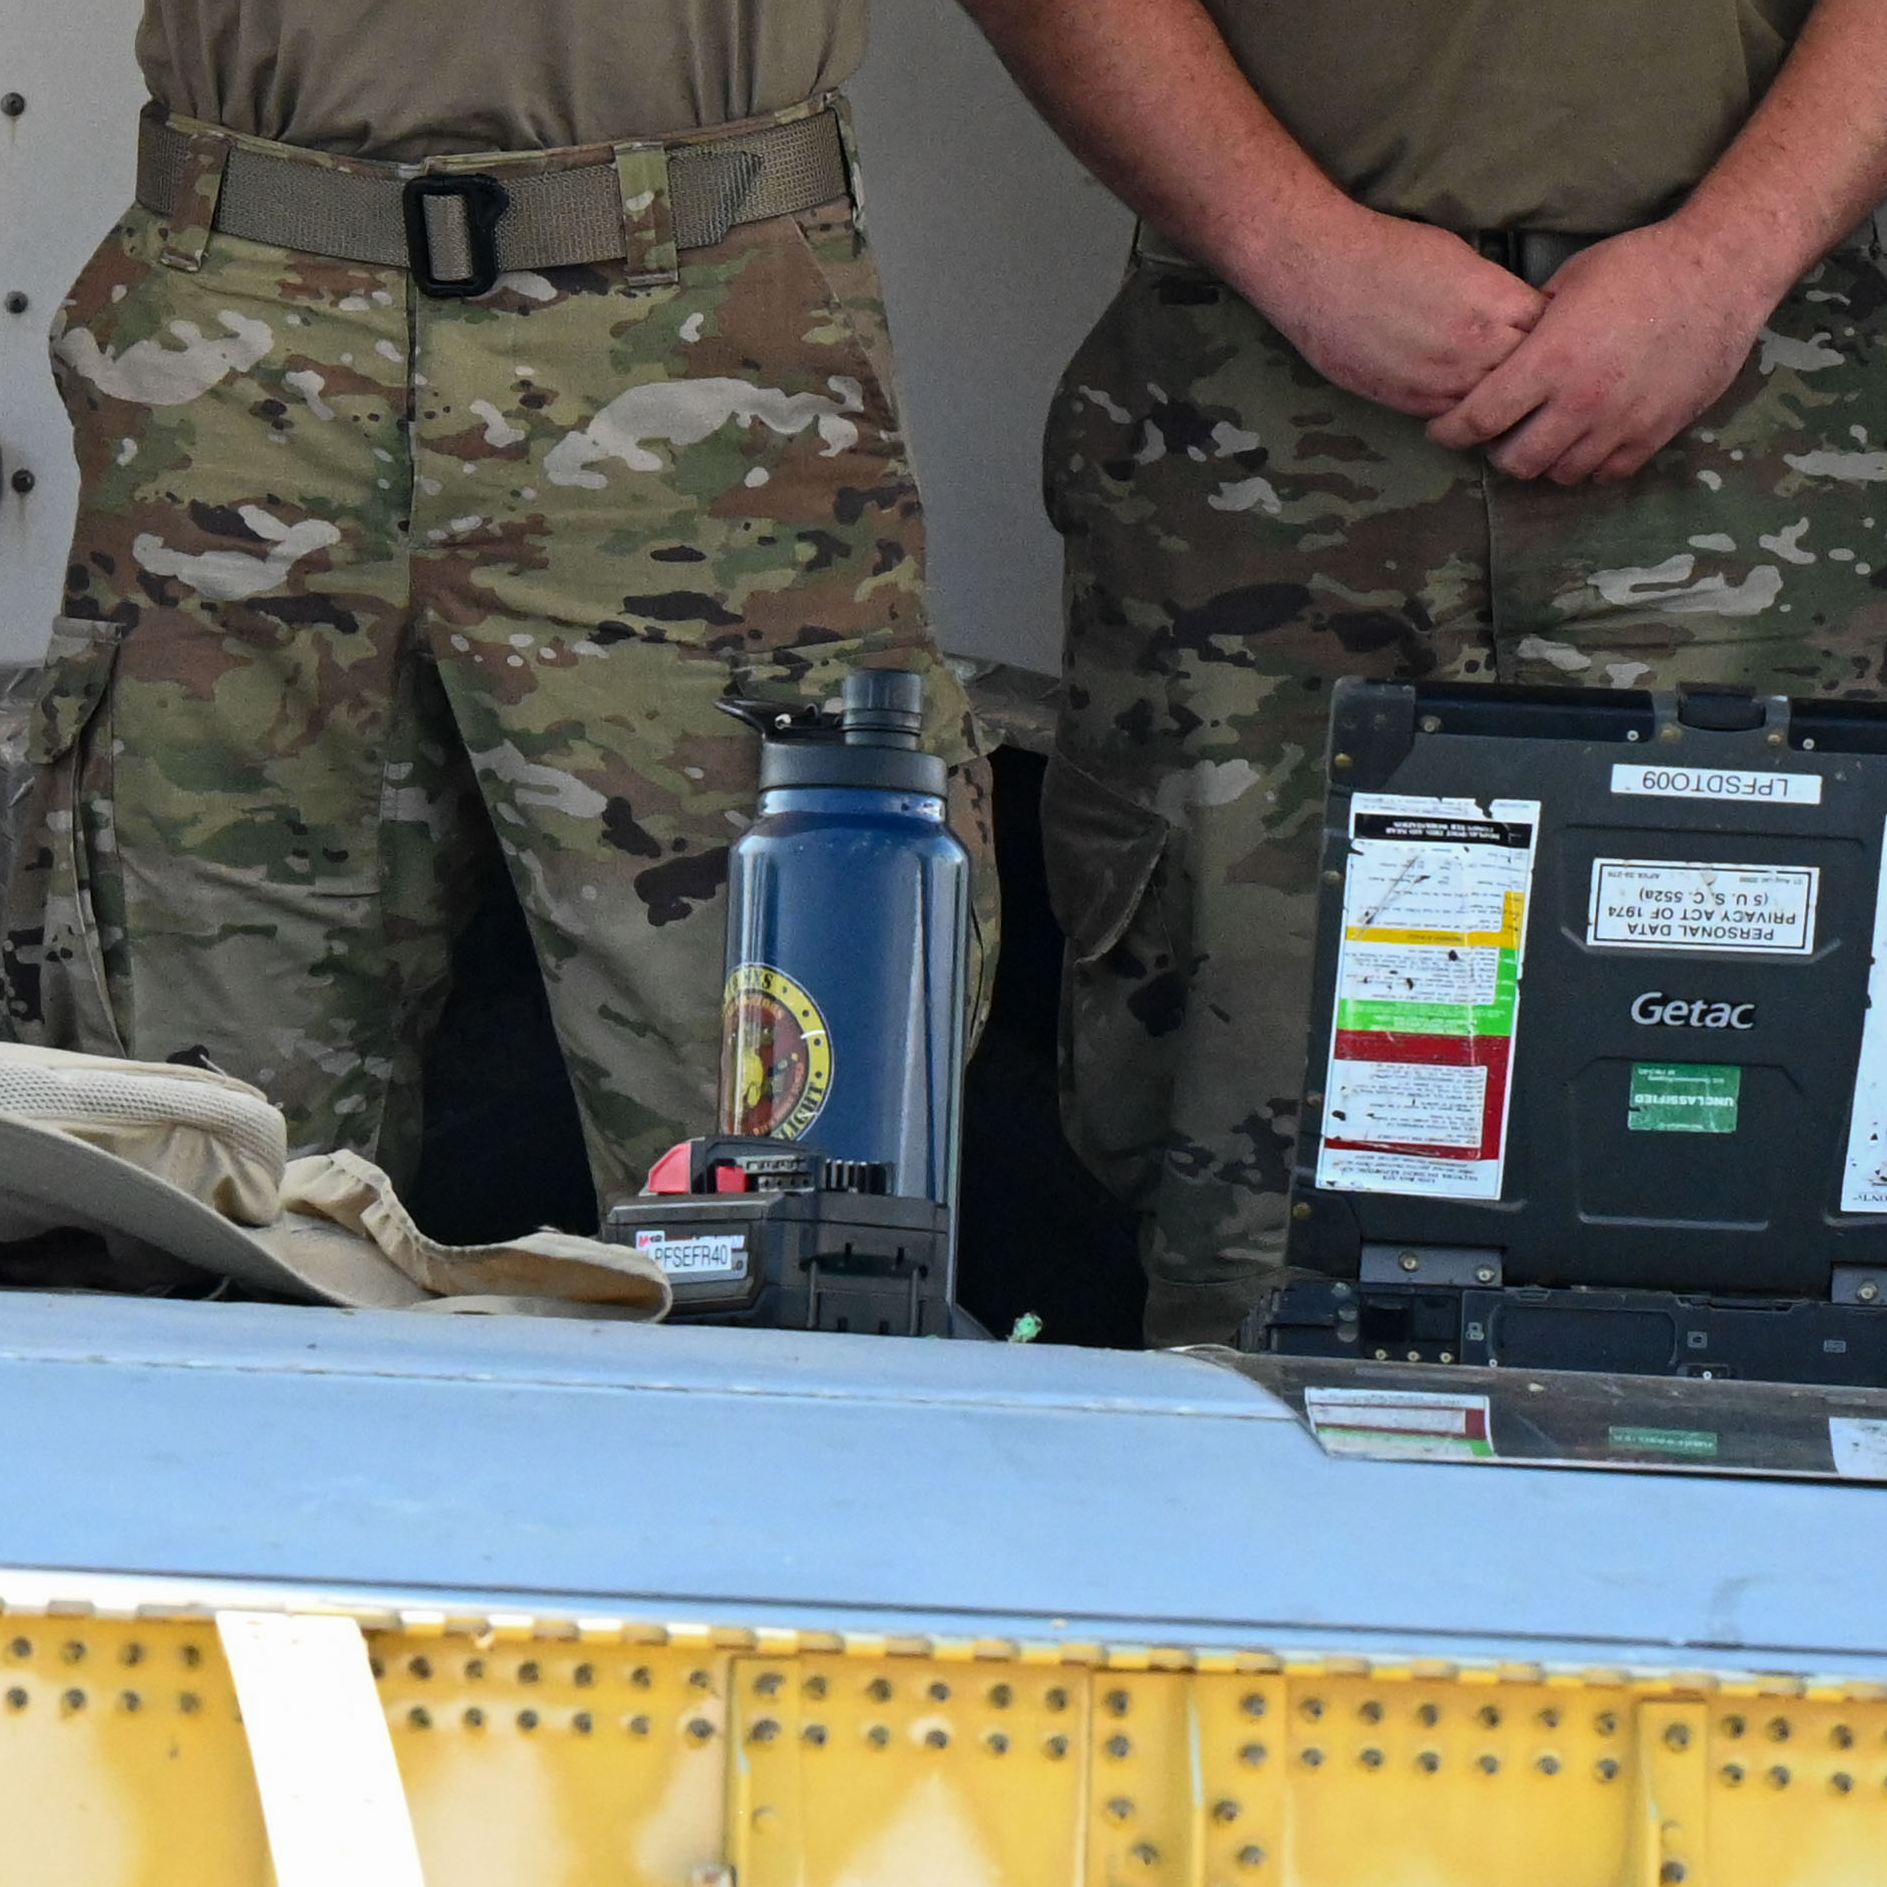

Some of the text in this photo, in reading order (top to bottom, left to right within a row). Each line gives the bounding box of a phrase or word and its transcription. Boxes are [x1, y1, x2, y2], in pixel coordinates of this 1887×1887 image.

[1639, 886, 1683, 902] 552a)
[1753, 893, 1769, 907] (5
[1608, 905, 1797, 925] PRIVACY ACT OF 1974
[1627, 922, 1775, 941] PERSONAL DATA
[1630, 992, 1755, 1029] Getac
[1634, 1094, 1734, 1107] UNCLASSIFIED
[779, 1081, 825, 1141] LIGHT
